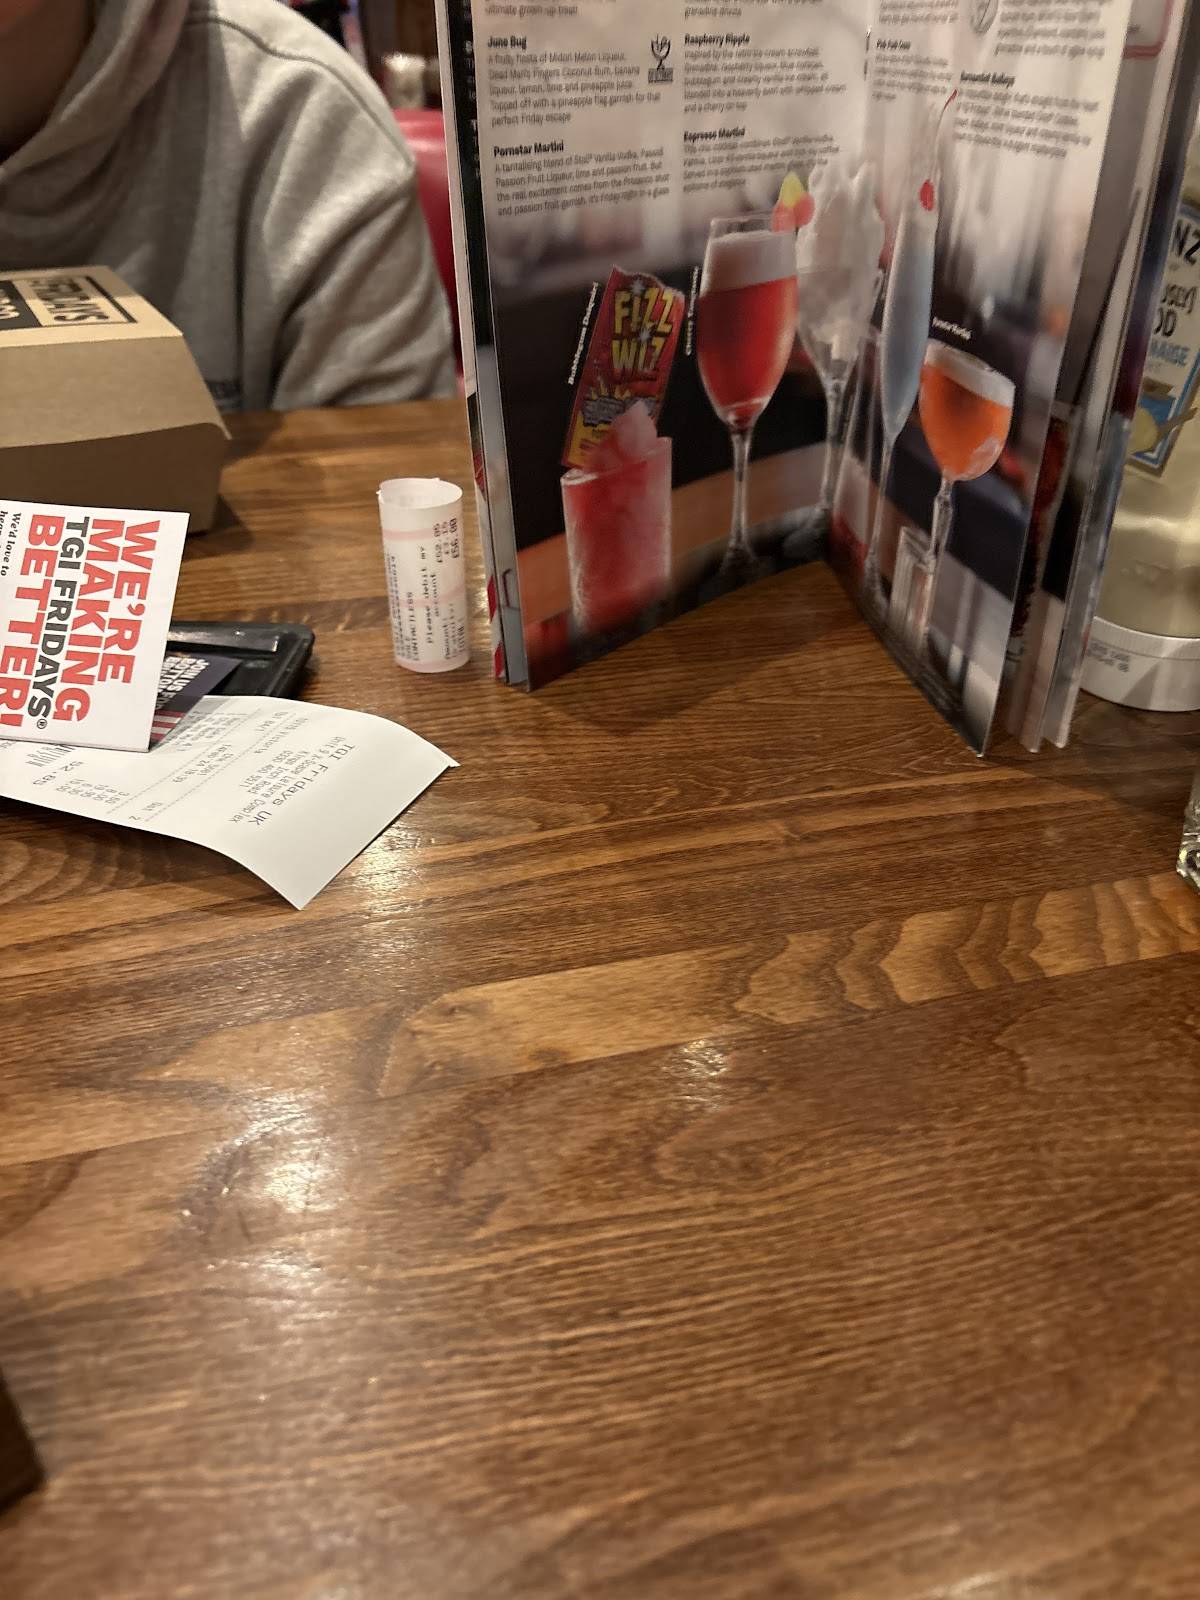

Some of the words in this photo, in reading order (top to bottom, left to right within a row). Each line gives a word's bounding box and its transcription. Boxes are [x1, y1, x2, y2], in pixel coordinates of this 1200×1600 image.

[487, 35, 509, 48] June
[510, 35, 527, 50] Bug
[685, 33, 724, 49] Raspberry
[725, 33, 750, 48] Ripple
[491, 114, 519, 128] perfect
[521, 112, 544, 126] Friday
[683, 130, 718, 143] Espresso
[718, 126, 745, 138] Martini
[493, 145, 532, 158] Pornstar
[533, 139, 564, 155] Martini
[496, 175, 526, 188] Passion
[528, 172, 545, 185] Fruit
[528, 185, 567, 200] excitement
[514, 201, 543, 215] passion
[614, 287, 675, 333] FIZZ
[611, 336, 666, 372] WIZ
[8, 512, 22, 538] We'd
[4, 540, 16, 563] love
[58, 516, 90, 570] TGI
[1, 565, 10, 576] to
[421, 567, 430, 599] debit
[97, 520, 161, 684] WE'RE
[0, 514, 65, 727] BETTER!
[53, 519, 125, 722] MAKING
[425, 606, 433, 644] Please
[180, 658, 210, 679] JOIN
[166, 679, 191, 692] US
[329, 743, 355, 760] TGI
[261, 776, 295, 798] Leisure
[272, 763, 328, 806] Fridays
[229, 798, 266, 823] Complex
[248, 810, 272, 825] UK
